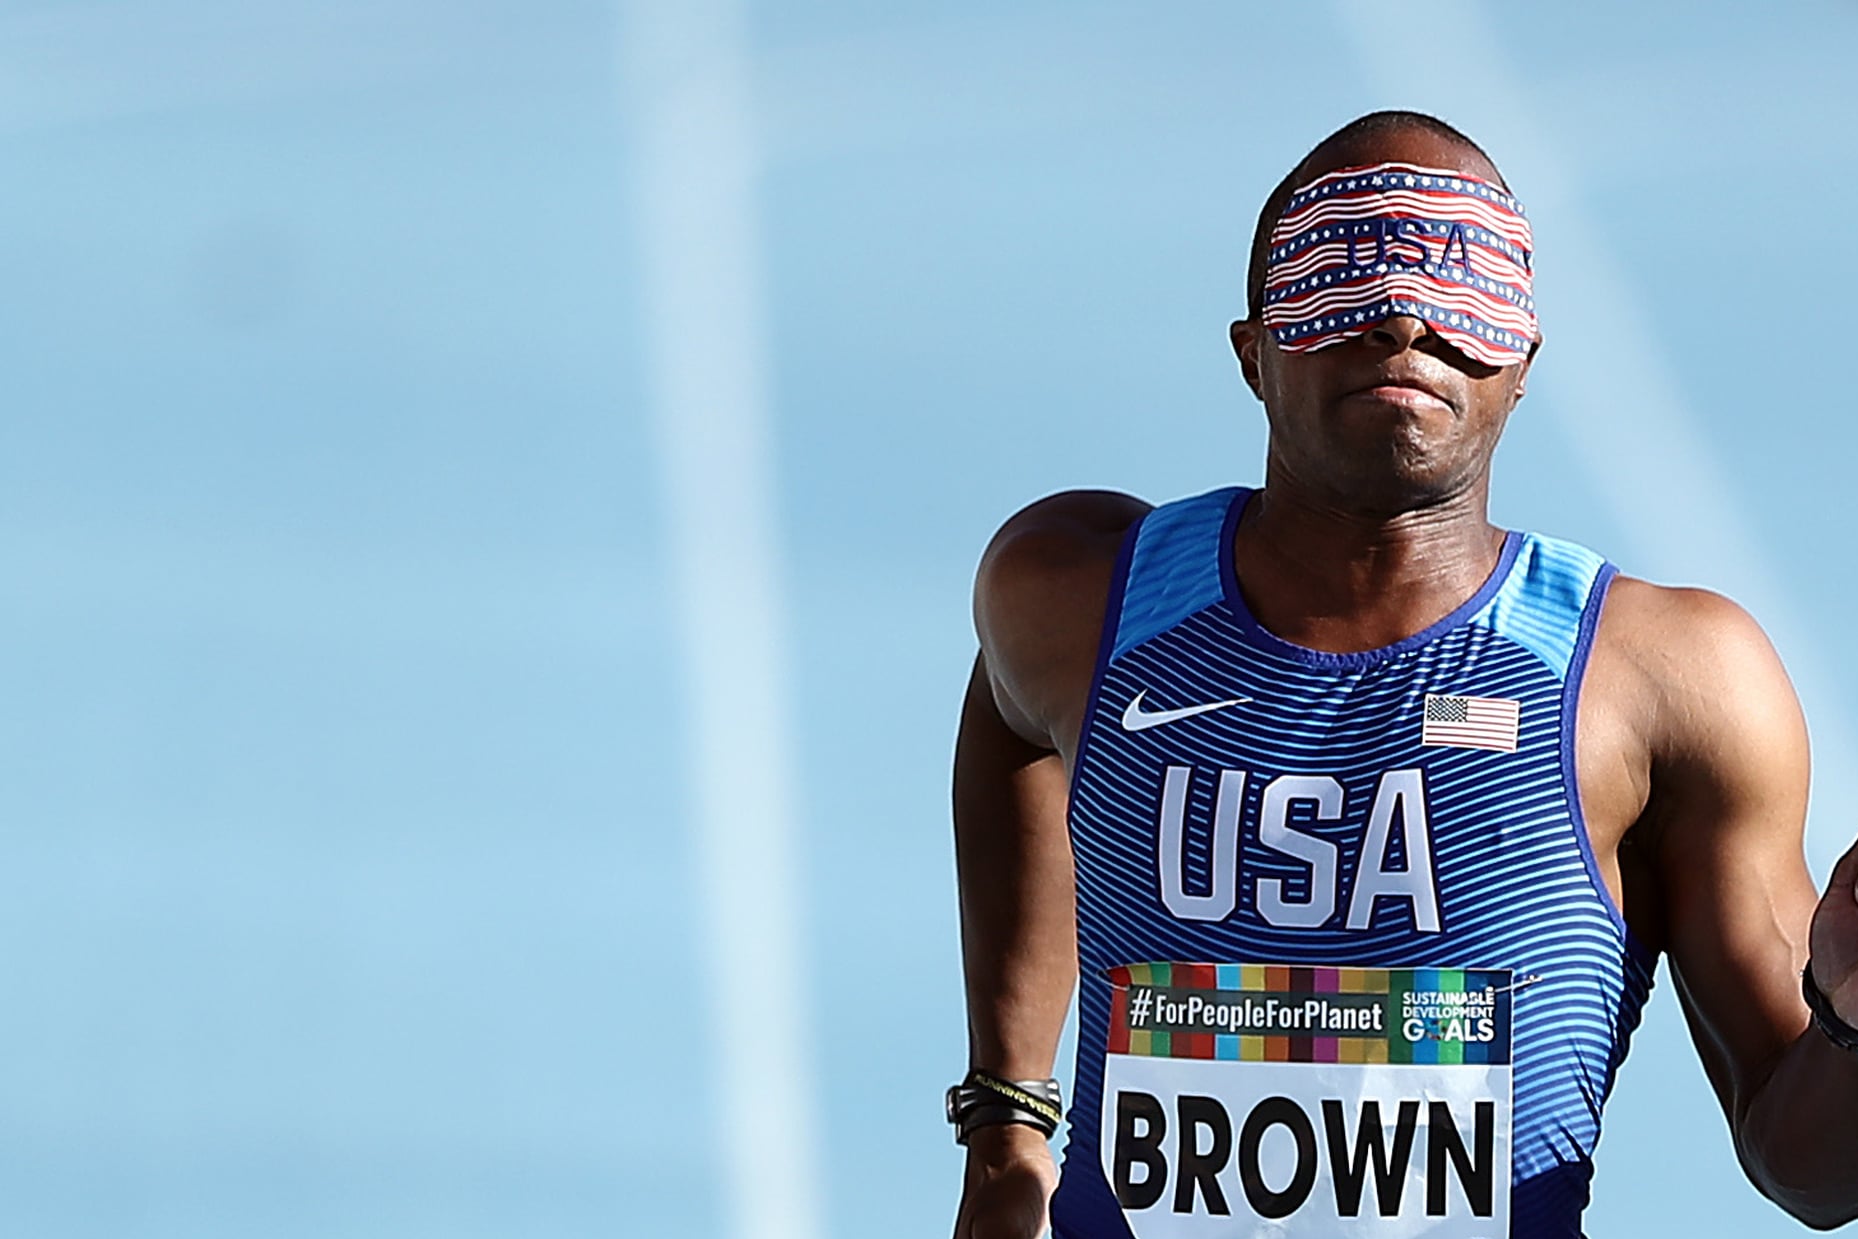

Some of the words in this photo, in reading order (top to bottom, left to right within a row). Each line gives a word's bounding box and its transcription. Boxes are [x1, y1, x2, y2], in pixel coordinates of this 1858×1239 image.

[1347, 219, 1474, 277] USA
[1158, 765, 1441, 932] USA
[1130, 989, 1383, 1032] #ForPeopleForPlanet
[1402, 991, 1495, 1005] SUSTAINABLE
[1402, 1006, 1495, 1018] DEVELOPMENT
[1113, 1091, 1495, 1218] BROWN
